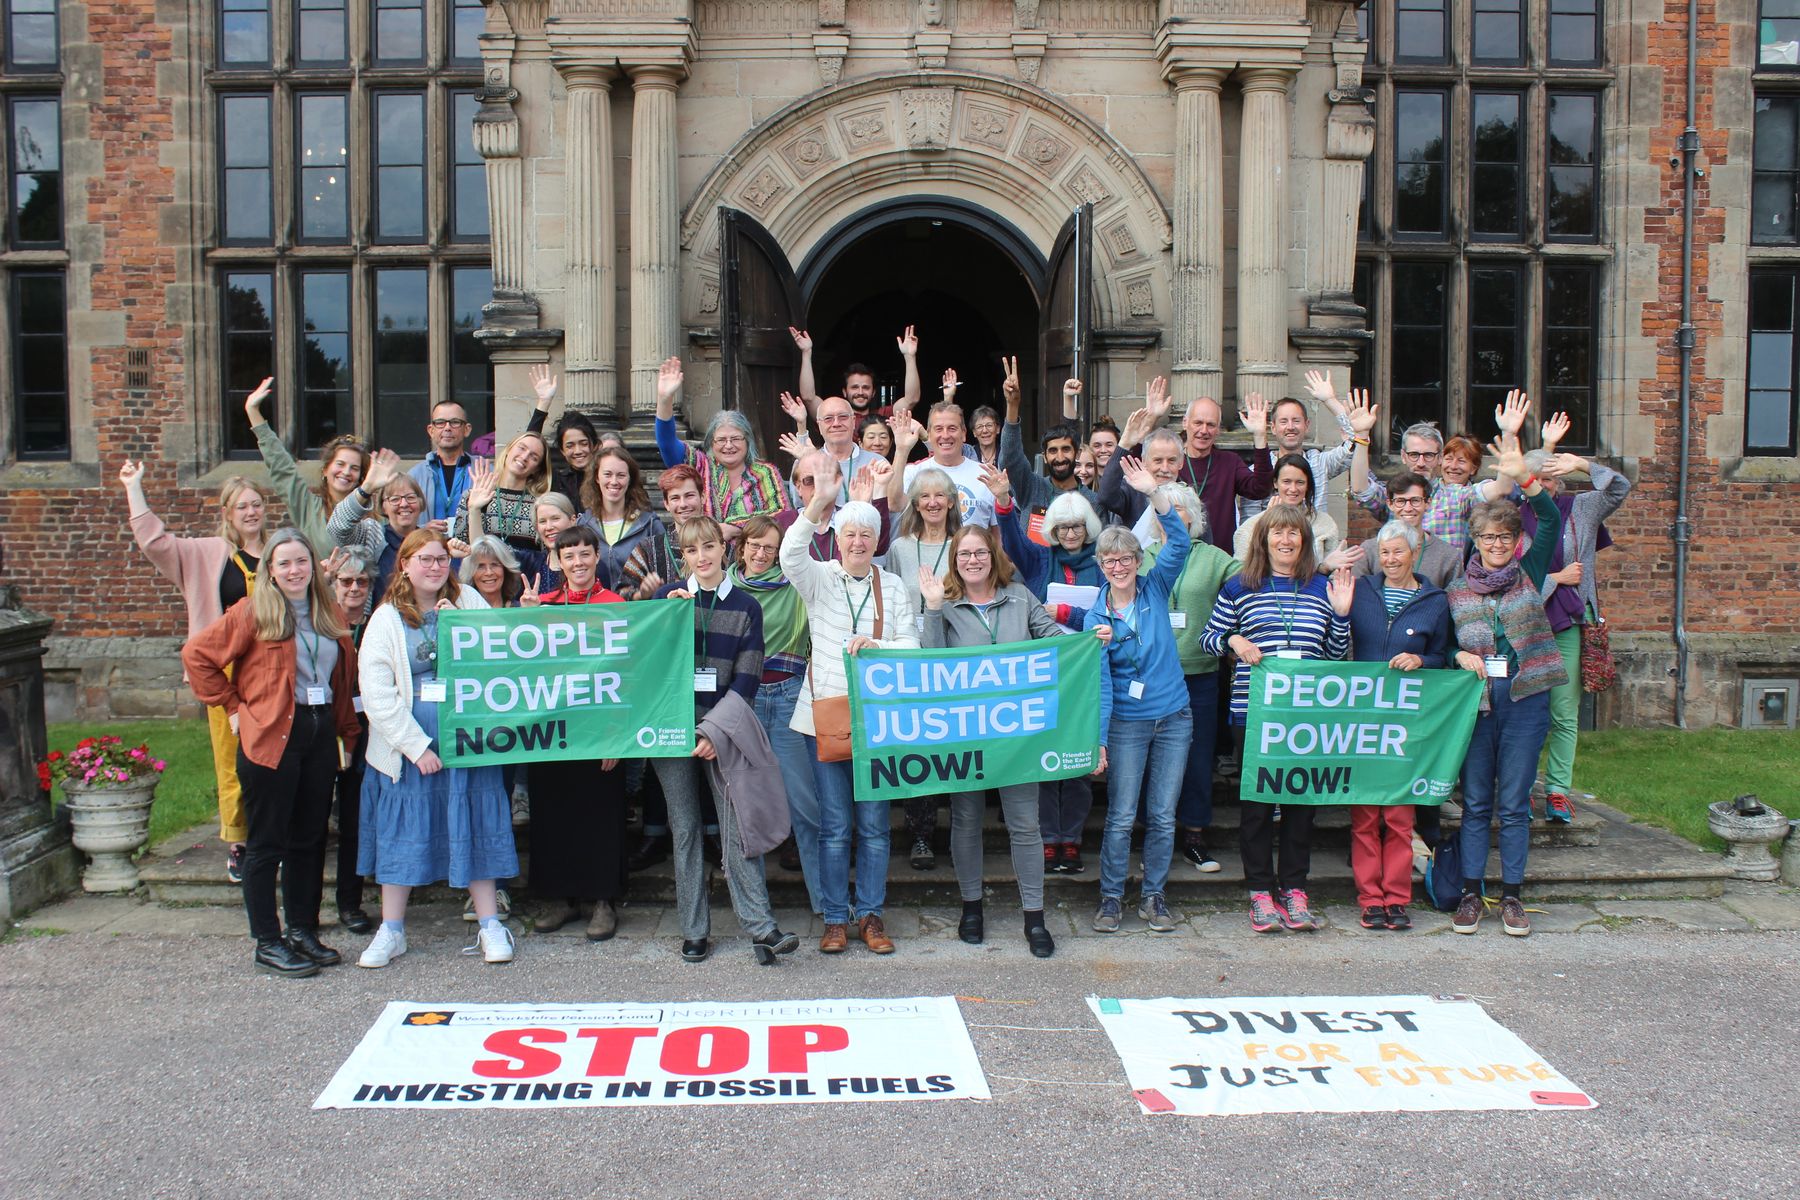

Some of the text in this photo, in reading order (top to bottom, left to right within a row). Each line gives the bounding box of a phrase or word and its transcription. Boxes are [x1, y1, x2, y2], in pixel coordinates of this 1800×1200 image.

[451, 620, 629, 660] PEOPLE
[864, 652, 1051, 696] CLIMATE
[1263, 672, 1423, 710] PEOPLE
[454, 672, 622, 713] POWER
[872, 697, 1046, 743] JUSTICE
[455, 720, 568, 757] NOW!
[1259, 721, 1408, 756] POWER
[870, 750, 985, 789] NOW!
[1062, 761, 1092, 770] Scotland
[1256, 766, 1352, 795] NOW!
[847, 1004, 929, 1014] POOL
[1171, 1010, 1422, 1034] DIVEST
[471, 1024, 850, 1078] STOP
[1242, 1042, 1425, 1063] FOR A
[352, 1075, 956, 1102] INVESTING IN FOSSIL FUELS
[1169, 1062, 1558, 1089] JUST FUTURE
